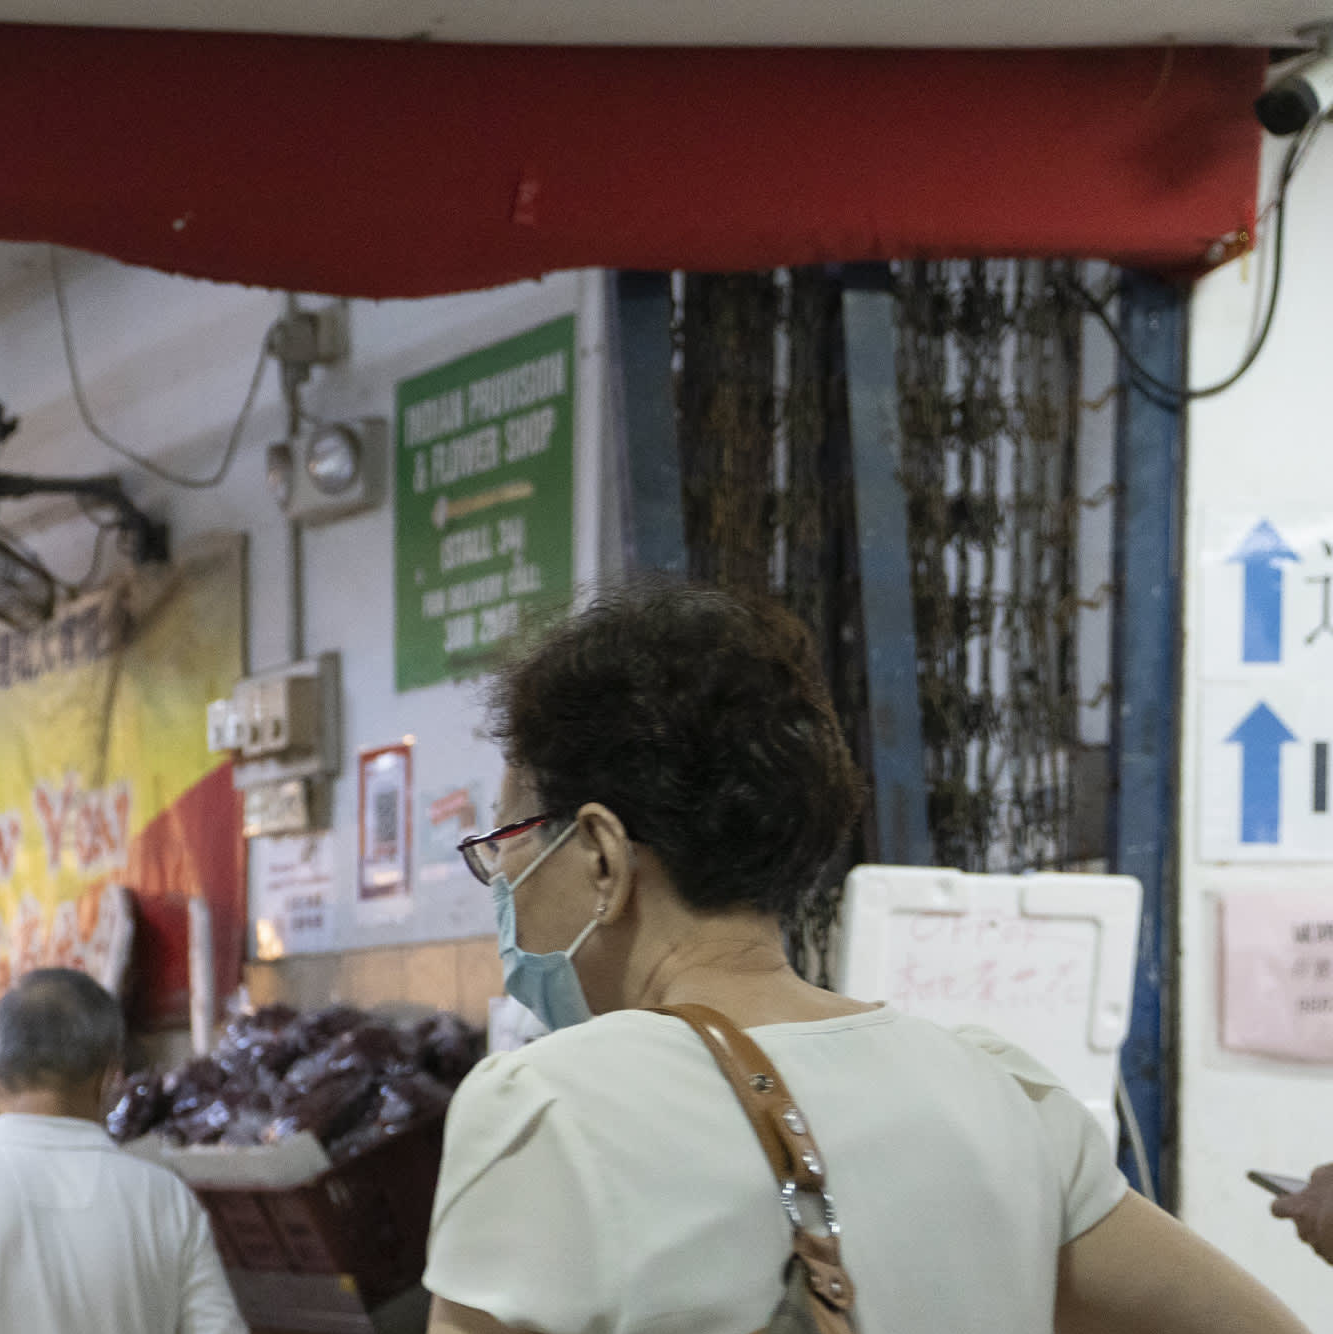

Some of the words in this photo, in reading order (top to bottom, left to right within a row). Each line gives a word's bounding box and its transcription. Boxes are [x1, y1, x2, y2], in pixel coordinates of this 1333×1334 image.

[405, 389, 464, 448] INDIAN
[468, 351, 566, 425] PROVISION
[413, 450, 429, 494] &
[431, 425, 501, 489] FLOWER
[505, 404, 555, 463] SHOP
[34, 774, 131, 874] Year
